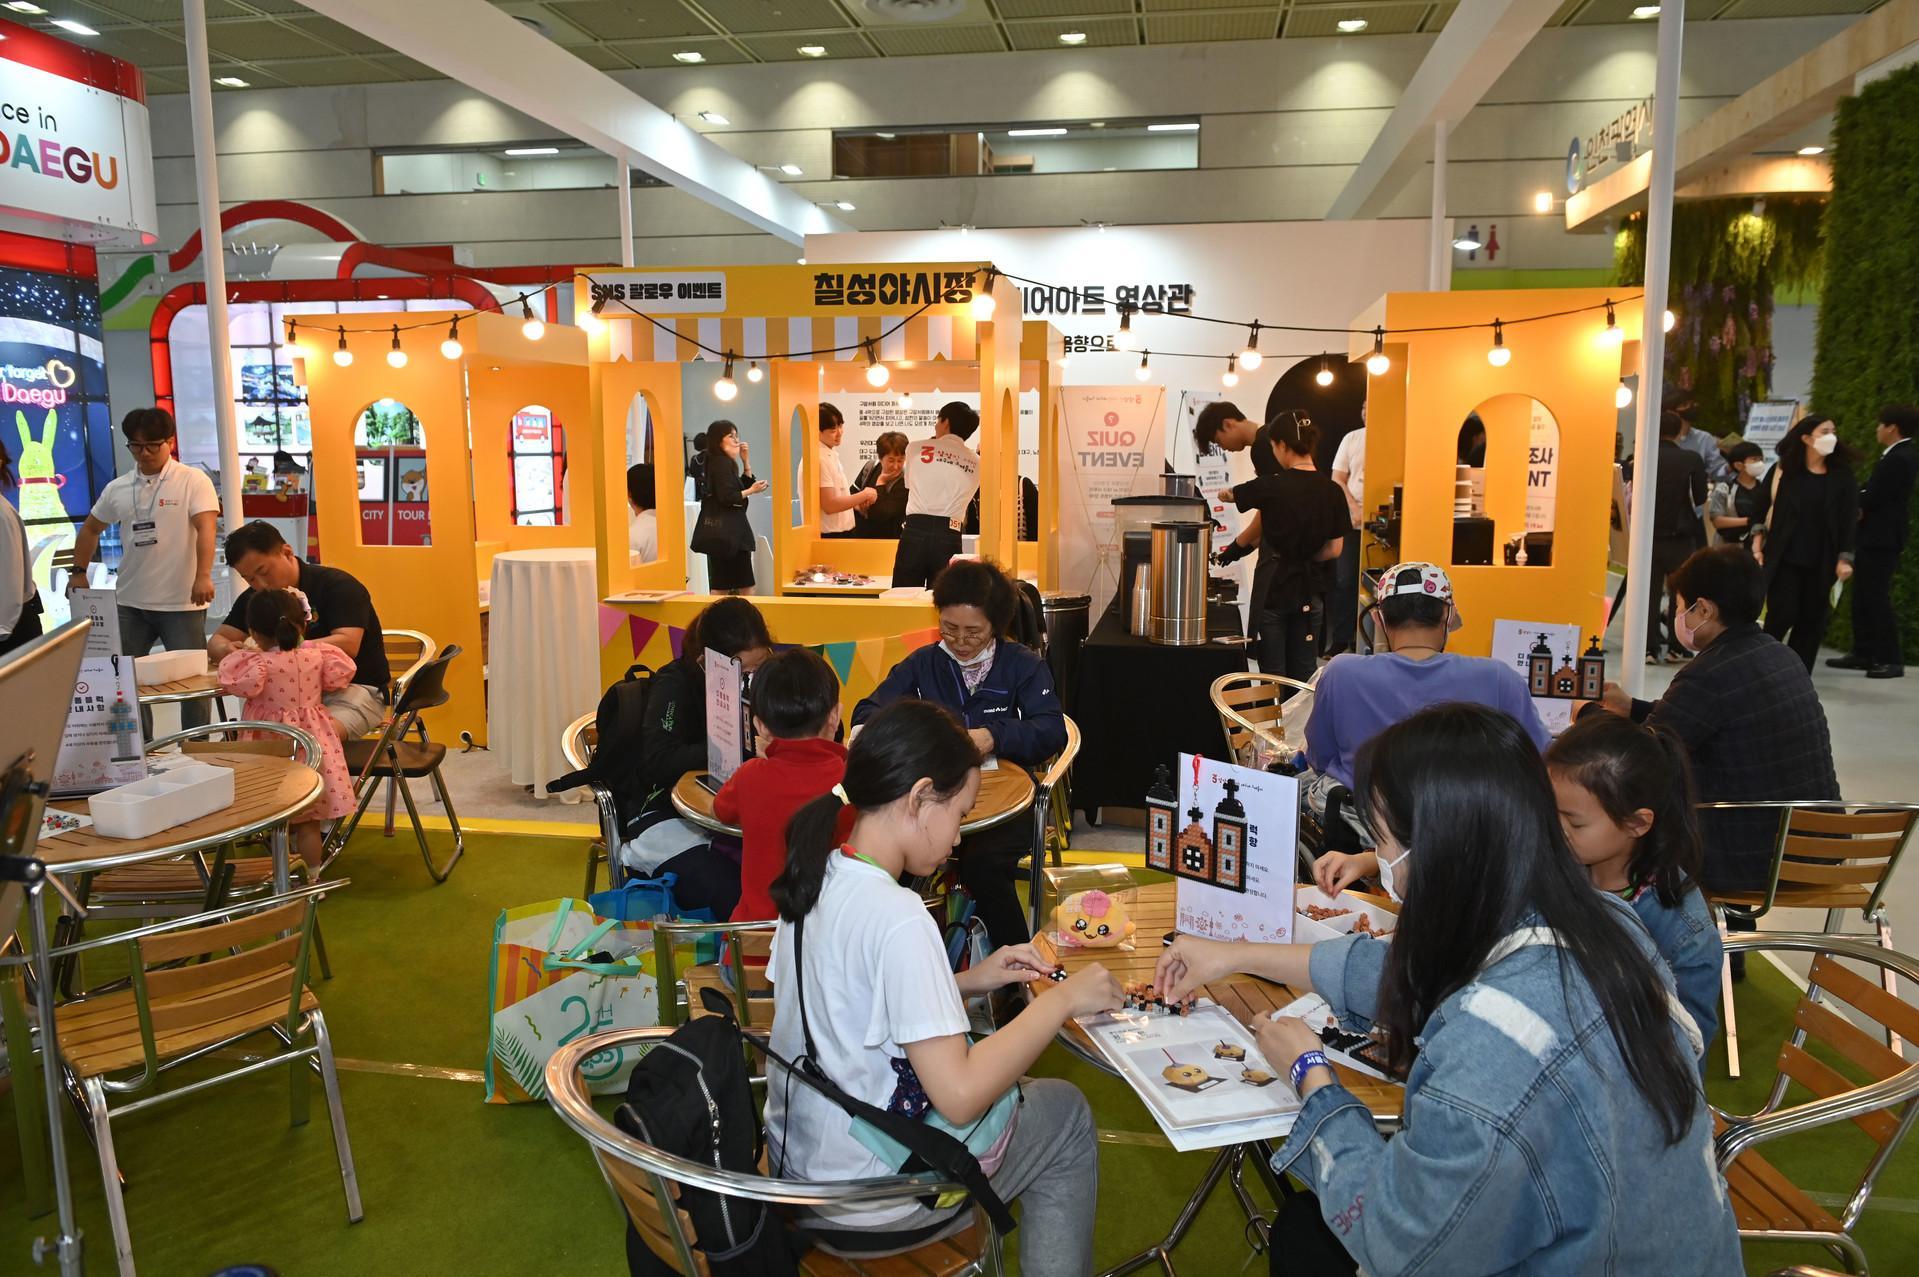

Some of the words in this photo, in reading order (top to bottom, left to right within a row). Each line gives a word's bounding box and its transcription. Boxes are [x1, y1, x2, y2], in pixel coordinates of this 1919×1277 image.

[1, 103, 30, 124] ce
[38, 106, 57, 132] in
[591, 284, 625, 301] SNS
[630, 283, 673, 300] 팔로우
[678, 282, 722, 299] 이벤트
[814, 272, 976, 305] 칠성야시장
[1116, 284, 1194, 314] 영상관
[1, 382, 66, 409] Daegu
[1529, 447, 1553, 465] 조사
[362, 510, 384, 520] CITY
[397, 510, 425, 520] TOUR
[69, 704, 105, 713] 내사항
